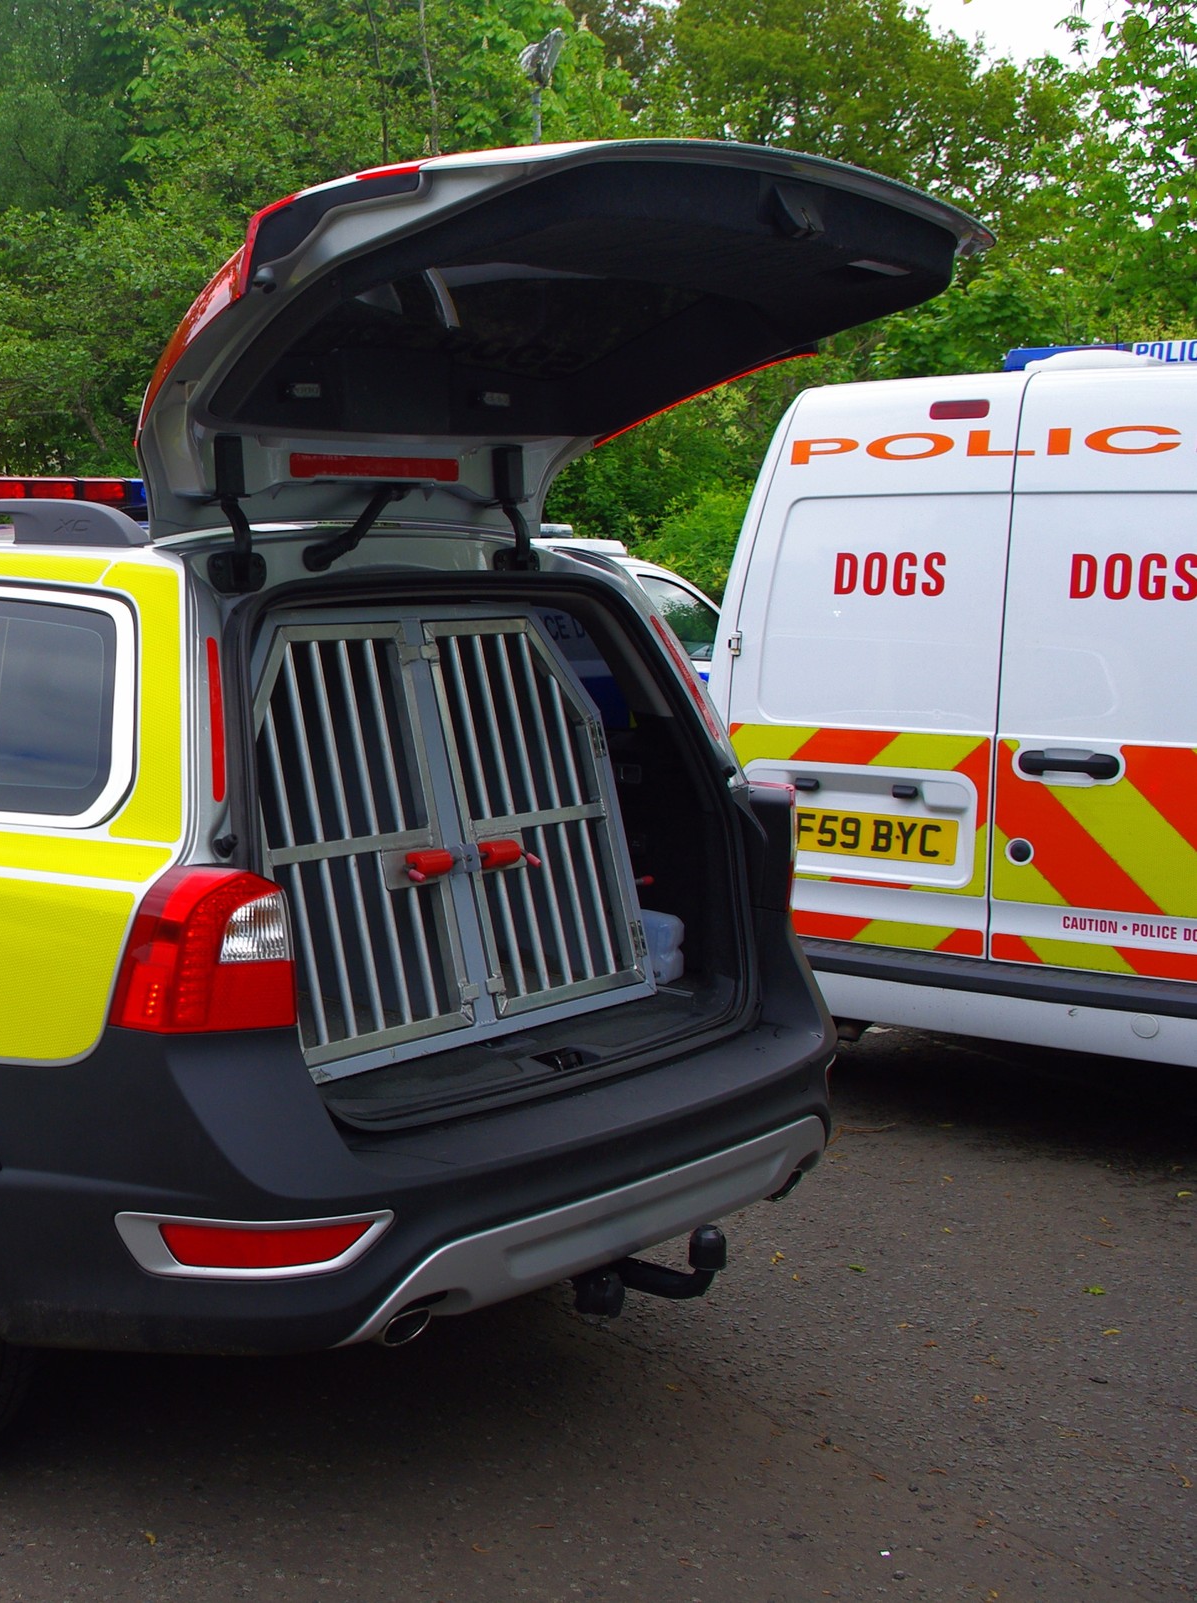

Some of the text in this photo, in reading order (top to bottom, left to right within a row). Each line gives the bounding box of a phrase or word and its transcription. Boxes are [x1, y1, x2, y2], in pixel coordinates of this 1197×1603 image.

[1135, 341, 1197, 363] POLIC
[790, 425, 1197, 466] POLIC
[53, 518, 91, 534] XC
[833, 551, 947, 597] DOGS
[1069, 553, 1197, 601] DOGS
[797, 812, 942, 858] F59 BYC
[1062, 915, 1197, 942] CAUTION POLICE DO
